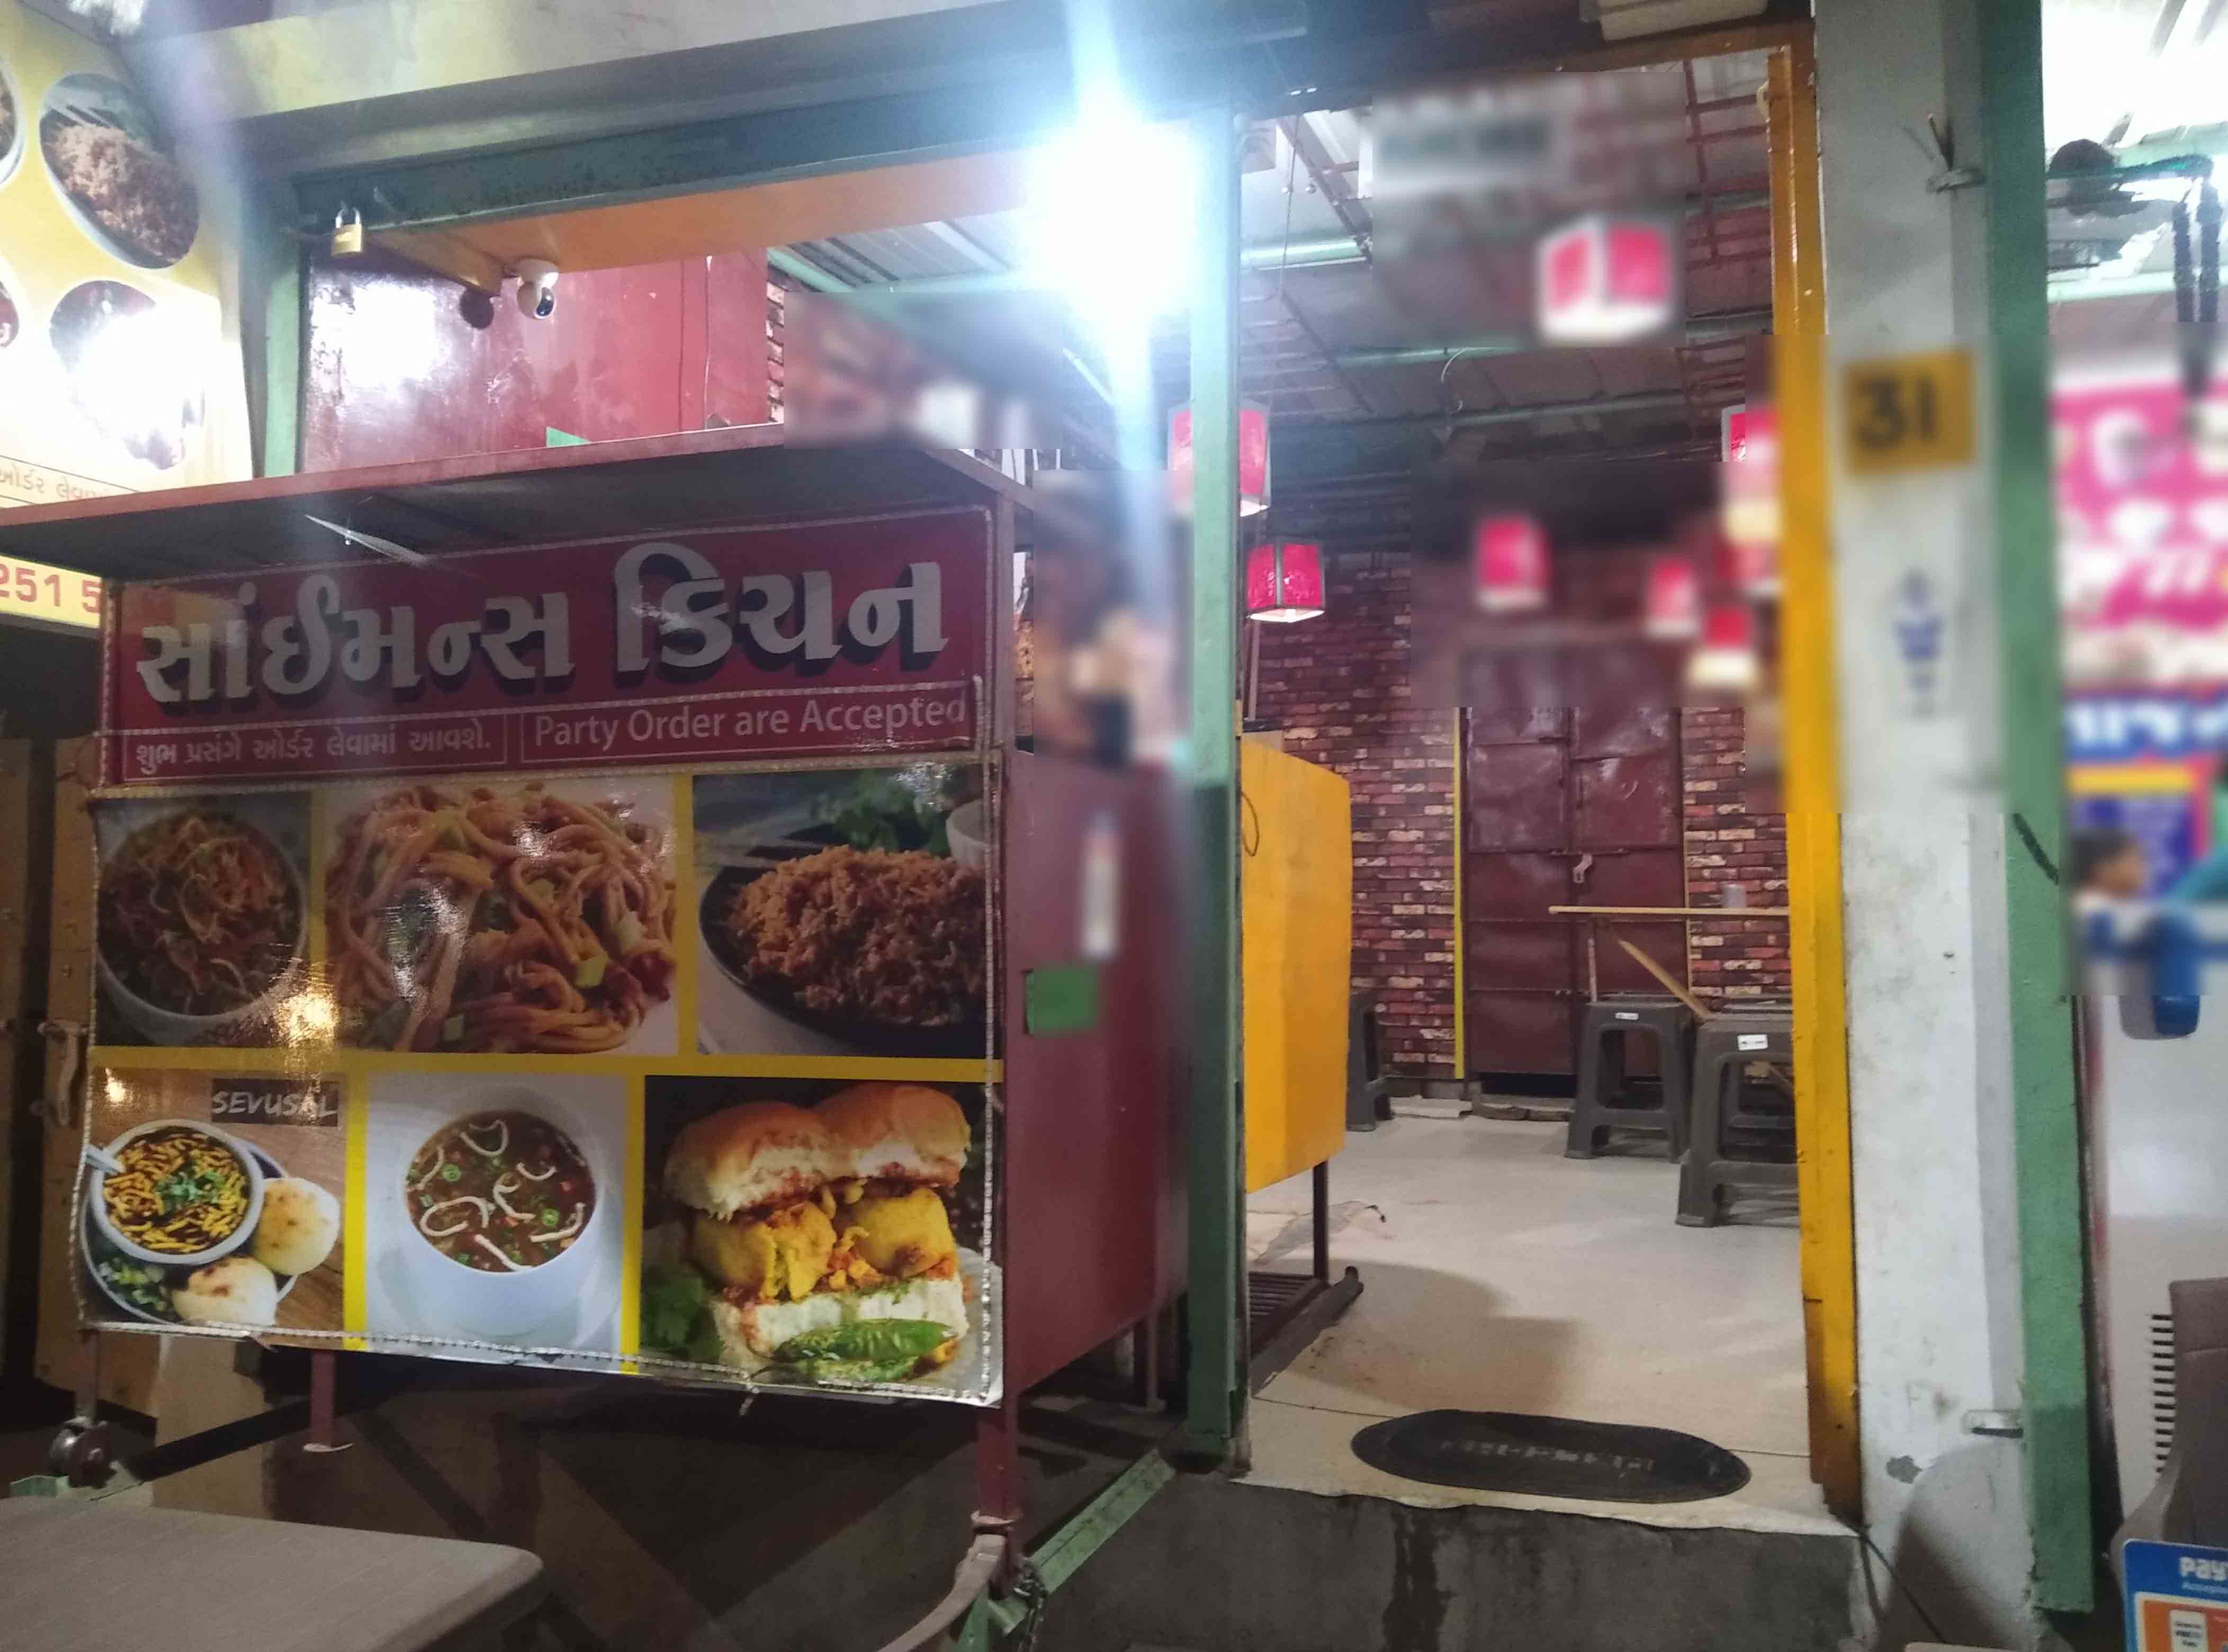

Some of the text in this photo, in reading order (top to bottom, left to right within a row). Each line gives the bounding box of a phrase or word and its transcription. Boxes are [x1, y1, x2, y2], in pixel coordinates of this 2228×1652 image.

[136, 542, 951, 703] સાંઈમન્સ કિચન
[135, 744, 177, 775] શુભ
[326, 722, 397, 756] લેવામાં
[535, 690, 967, 752] Party Order are Accepted
